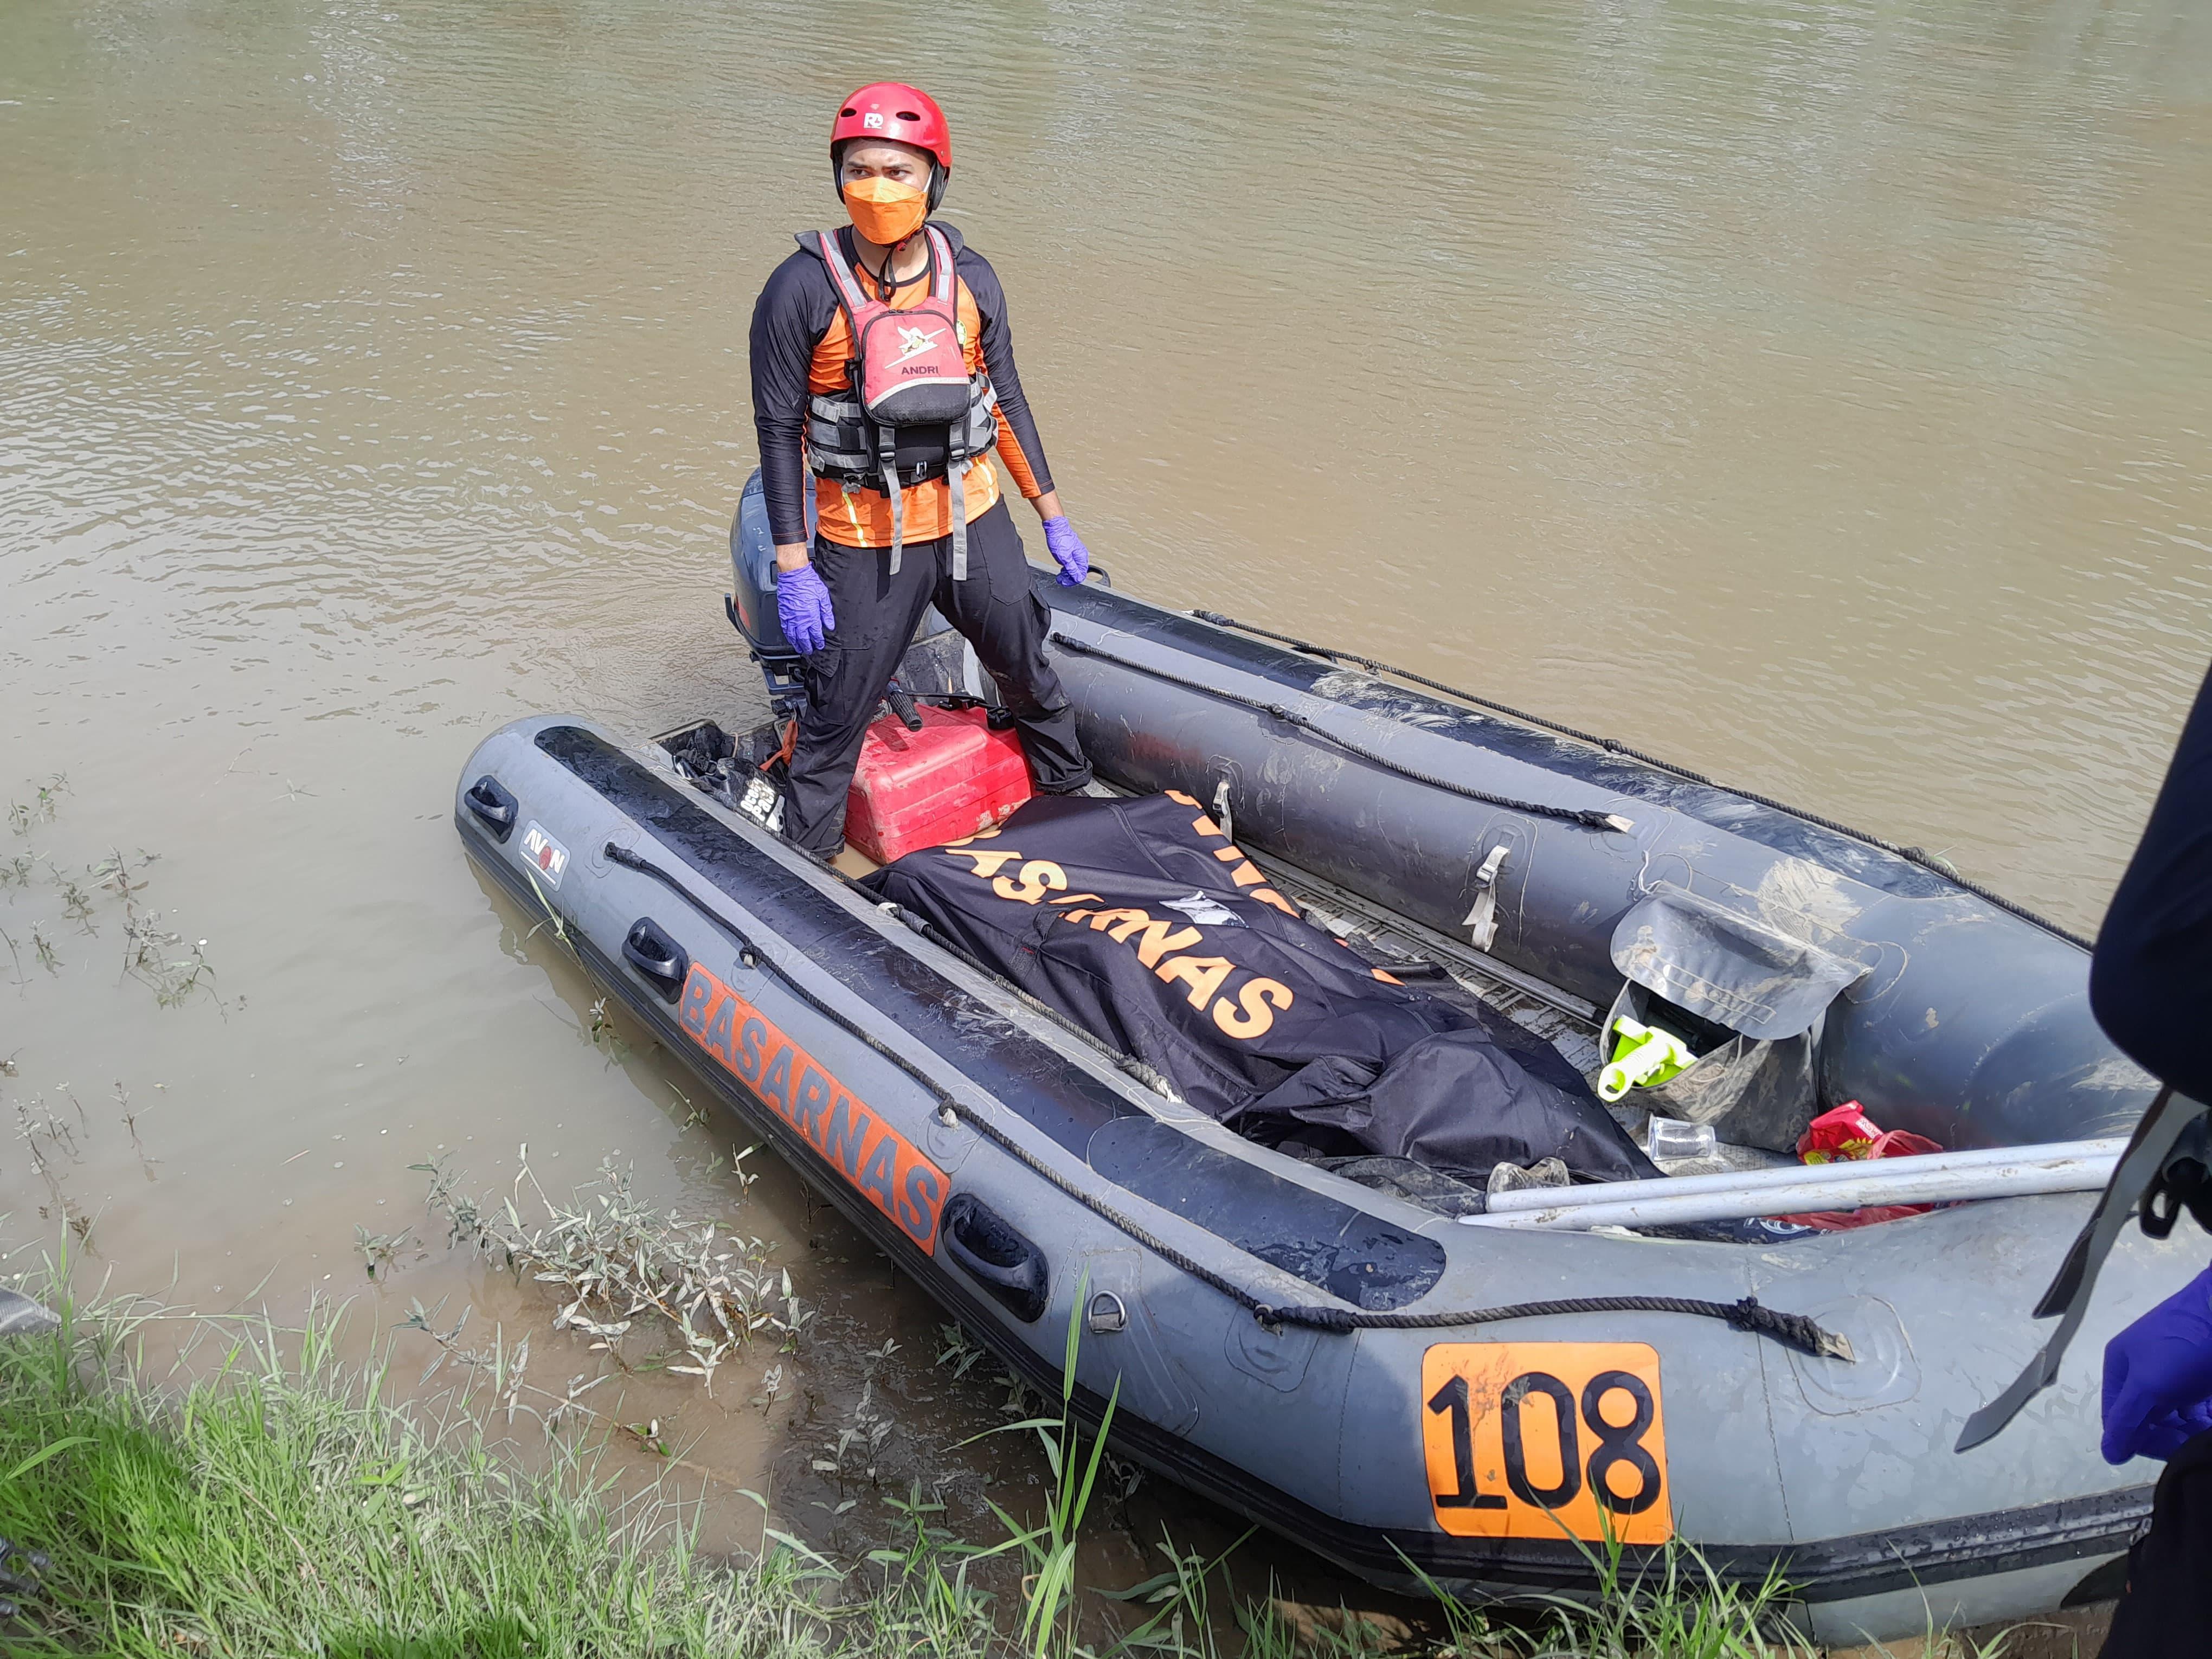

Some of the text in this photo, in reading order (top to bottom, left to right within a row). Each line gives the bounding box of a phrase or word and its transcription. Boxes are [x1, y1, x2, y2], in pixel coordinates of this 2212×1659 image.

[901, 365, 939, 375] ANDRI
[523, 828, 565, 874] AVON
[682, 967, 940, 1241] BASARNAS
[1427, 1370, 1661, 1515] 108
